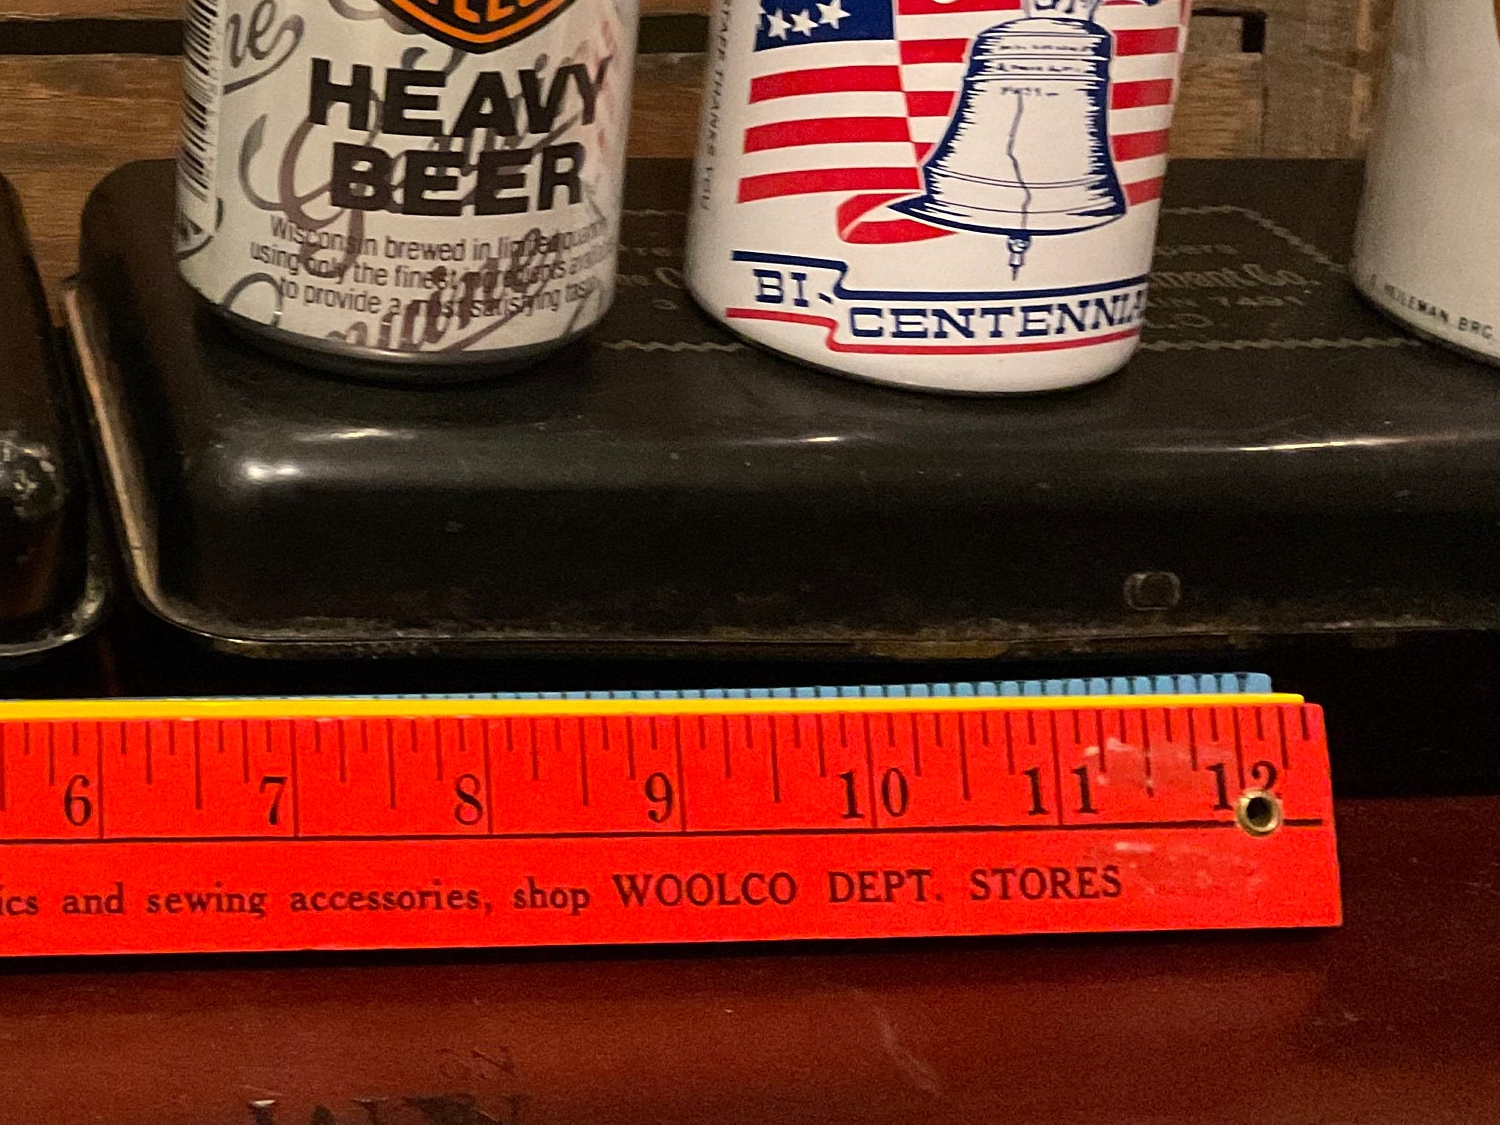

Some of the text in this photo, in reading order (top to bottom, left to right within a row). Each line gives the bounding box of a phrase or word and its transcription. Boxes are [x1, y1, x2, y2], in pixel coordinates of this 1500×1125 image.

[309, 54, 614, 138] HEAVY
[330, 140, 587, 217] BEER
[251, 241, 300, 276] using
[352, 260, 389, 286] the
[385, 235, 466, 261] brewed
[473, 237, 491, 260] in
[304, 284, 383, 314] provide
[63, 773, 94, 827] 6
[258, 775, 289, 827] 7
[453, 772, 484, 826] 8
[644, 770, 675, 824] 9
[838, 766, 909, 819] 10
[1025, 764, 1099, 816] 11
[62, 881, 125, 915] and
[146, 880, 268, 920] sewing
[289, 877, 493, 915] accessories,
[512, 875, 591, 916] shop
[611, 871, 798, 908] WOOLCO
[827, 868, 943, 904] DEPT.
[970, 865, 1123, 902] STORES
